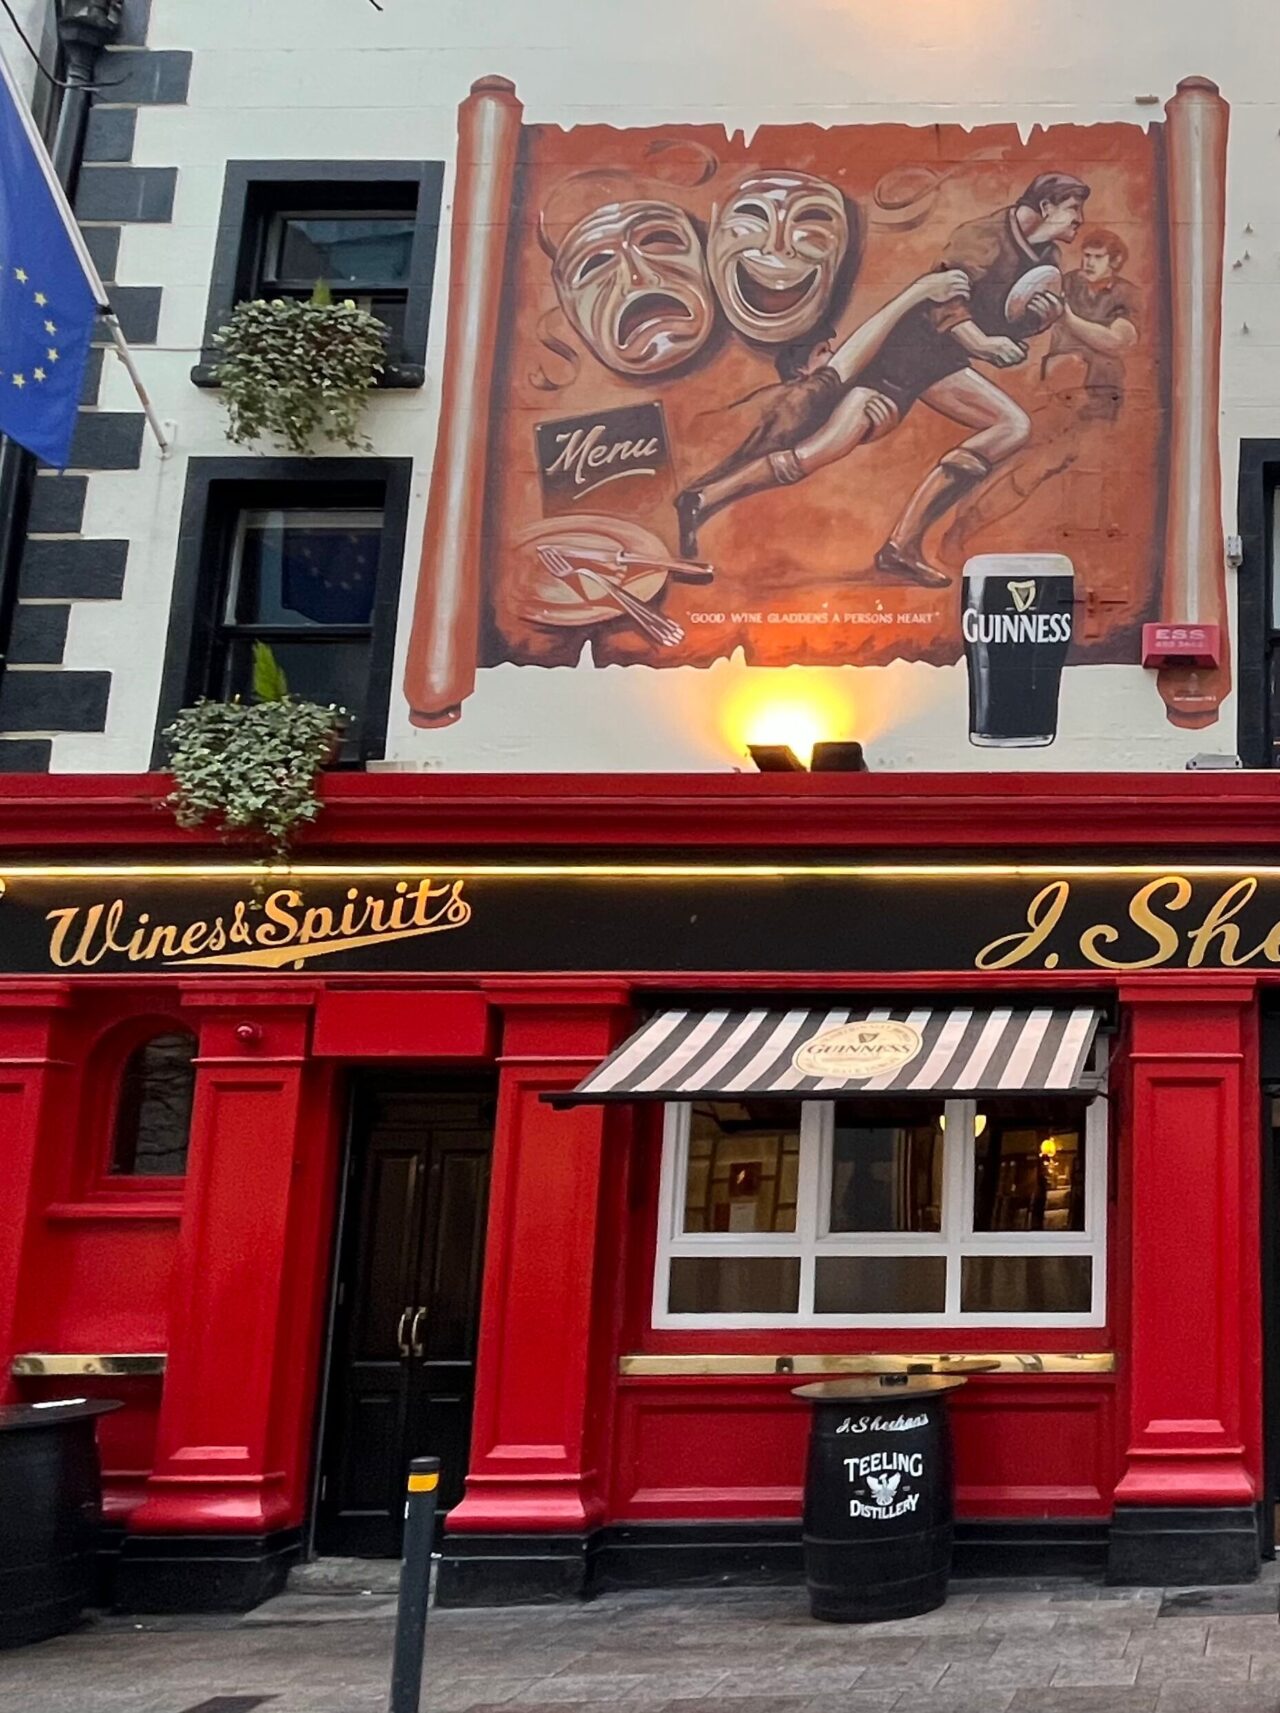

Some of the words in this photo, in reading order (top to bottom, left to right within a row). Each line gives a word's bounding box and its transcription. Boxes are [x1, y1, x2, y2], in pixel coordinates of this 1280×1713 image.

[545, 425, 658, 484] Menu
[731, 612, 763, 624] WINE
[767, 612, 829, 624] GLADDENS
[832, 612, 841, 624] A
[844, 612, 894, 624] PERSONS
[962, 607, 1072, 643] GUINNESS
[975, 880, 1070, 969] J.
[844, 1452, 924, 1482] TEELING
[850, 1493, 920, 1520] DISTILLERY
